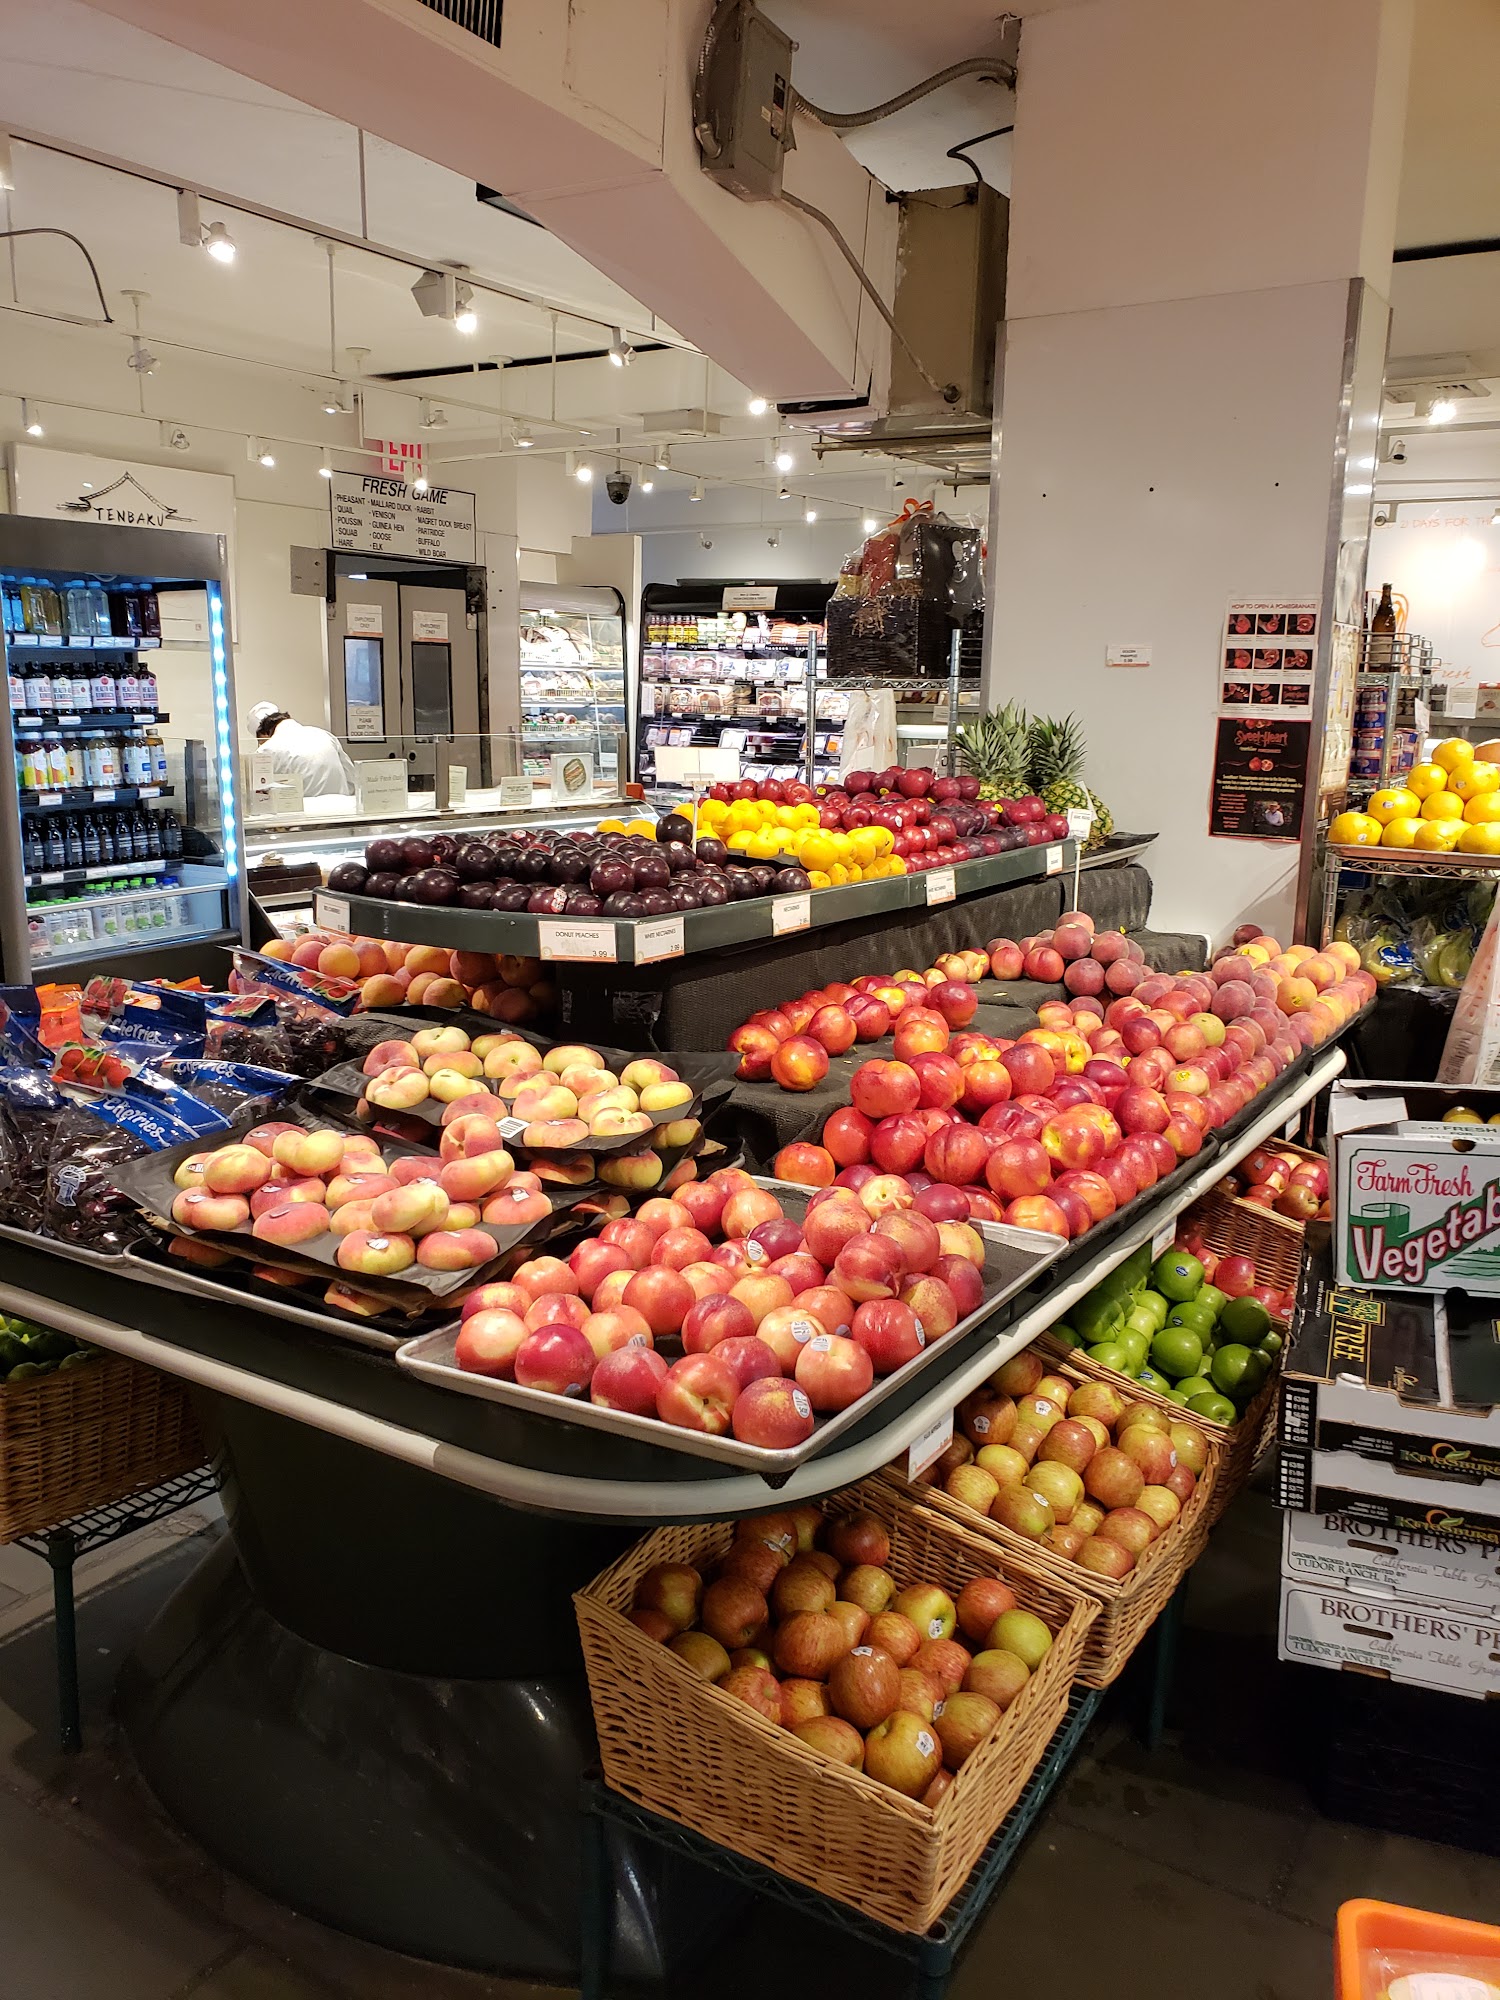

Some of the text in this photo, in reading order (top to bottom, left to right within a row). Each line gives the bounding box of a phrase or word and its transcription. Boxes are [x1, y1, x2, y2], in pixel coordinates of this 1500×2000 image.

[363, 478, 448, 504] FRESH GAME
[336, 494, 365, 505] PHEASANT
[337, 505, 354, 514] QUAIL
[371, 499, 412, 512] MALLARD DUCK
[417, 506, 435, 515] RABBIT
[93, 507, 164, 527] TENBAKU
[372, 510, 395, 520] VENISON
[338, 516, 362, 526] POUSSIN
[372, 521, 405, 532] GUINEA HEN
[418, 516, 472, 531] MAGRET DUCK BREAST
[1445, 518, 1469, 527] FOR
[338, 527, 358, 537] SQUAB
[373, 532, 392, 541] GOOSE
[418, 527, 445, 537] PARTRIDGE
[339, 539, 354, 547] HARE
[373, 543, 383, 551] ELK
[418, 538, 440, 547] BUFFALO
[419, 548, 447, 558] WILD BOAR
[102, 1095, 173, 1148] Cherries
[1356, 1159, 1474, 1196] Farm Fresh
[1332, 1321, 1367, 1363] TREE
[1322, 1513, 1468, 1555] BROTHERS
[1296, 1558, 1335, 1573] TUDOR
[1373, 1554, 1428, 1575] California
[1432, 1564, 1467, 1582] Table
[1320, 1598, 1468, 1642] BROTHERS'
[1293, 1641, 1332, 1656] TUDOR
[1368, 1640, 1423, 1660] California
[1428, 1650, 1462, 1668] Table
